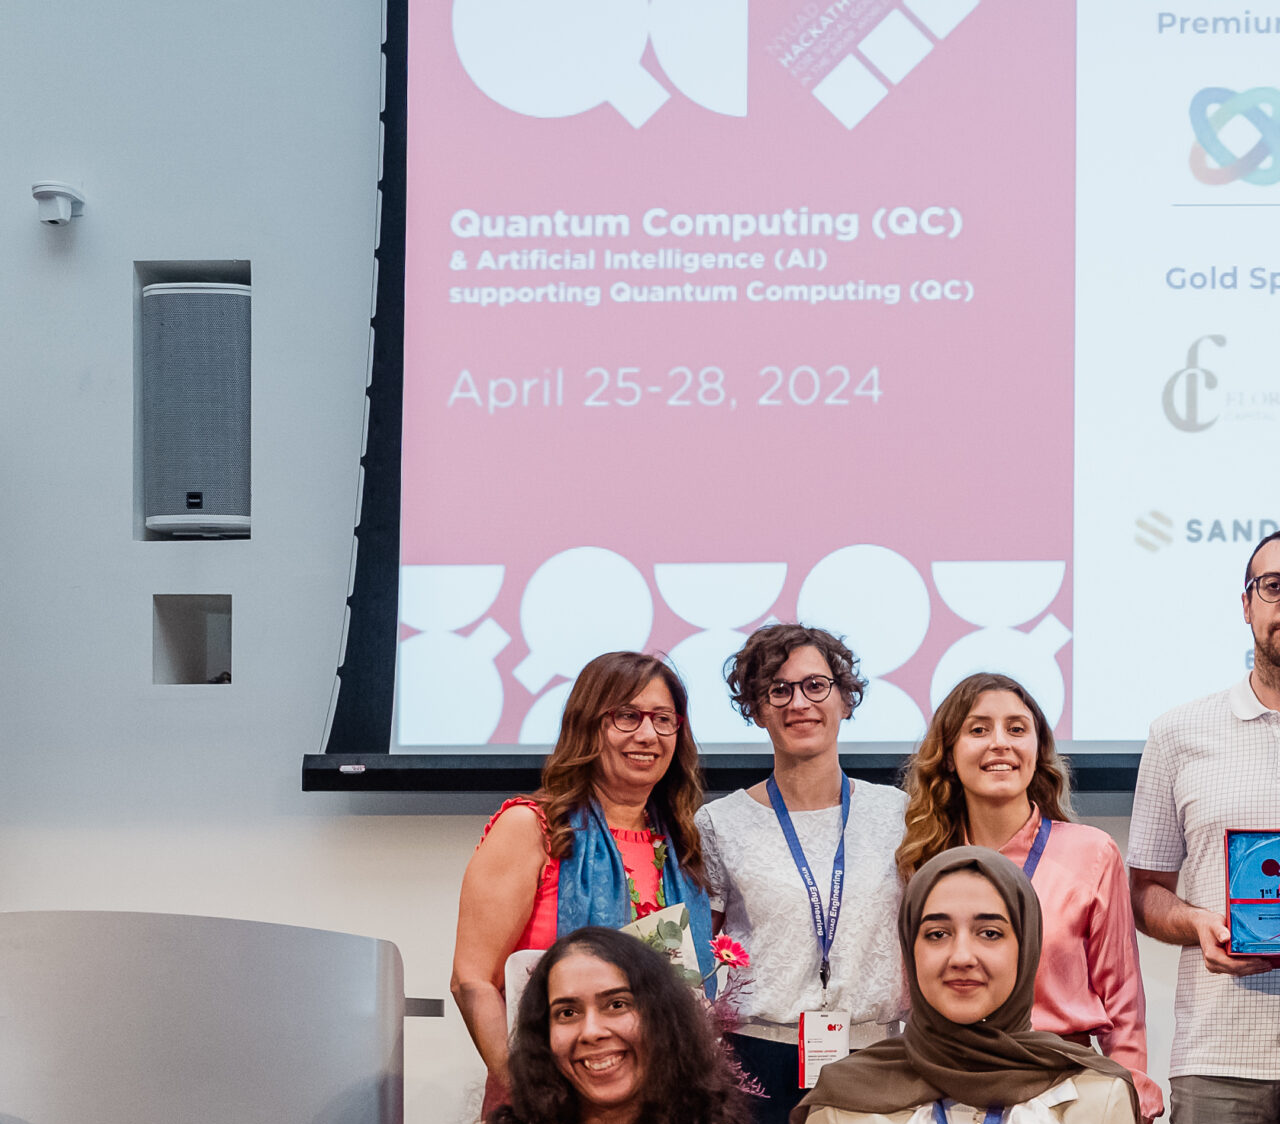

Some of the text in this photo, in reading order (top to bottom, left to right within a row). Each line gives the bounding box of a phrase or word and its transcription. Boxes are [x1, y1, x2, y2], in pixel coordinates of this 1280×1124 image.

[777, 0, 852, 68] HACKATH
[450, 205, 964, 242] Quantum Computing (QC)
[449, 248, 828, 273] & Artificial Intelligence (AI)
[1165, 266, 1239, 290] Gold
[448, 279, 975, 306] supporting Quantum Computing (QC)
[447, 365, 883, 414] April 25-28, 2024
[809, 886, 824, 936] Engineering
[829, 869, 843, 918] Engineering
